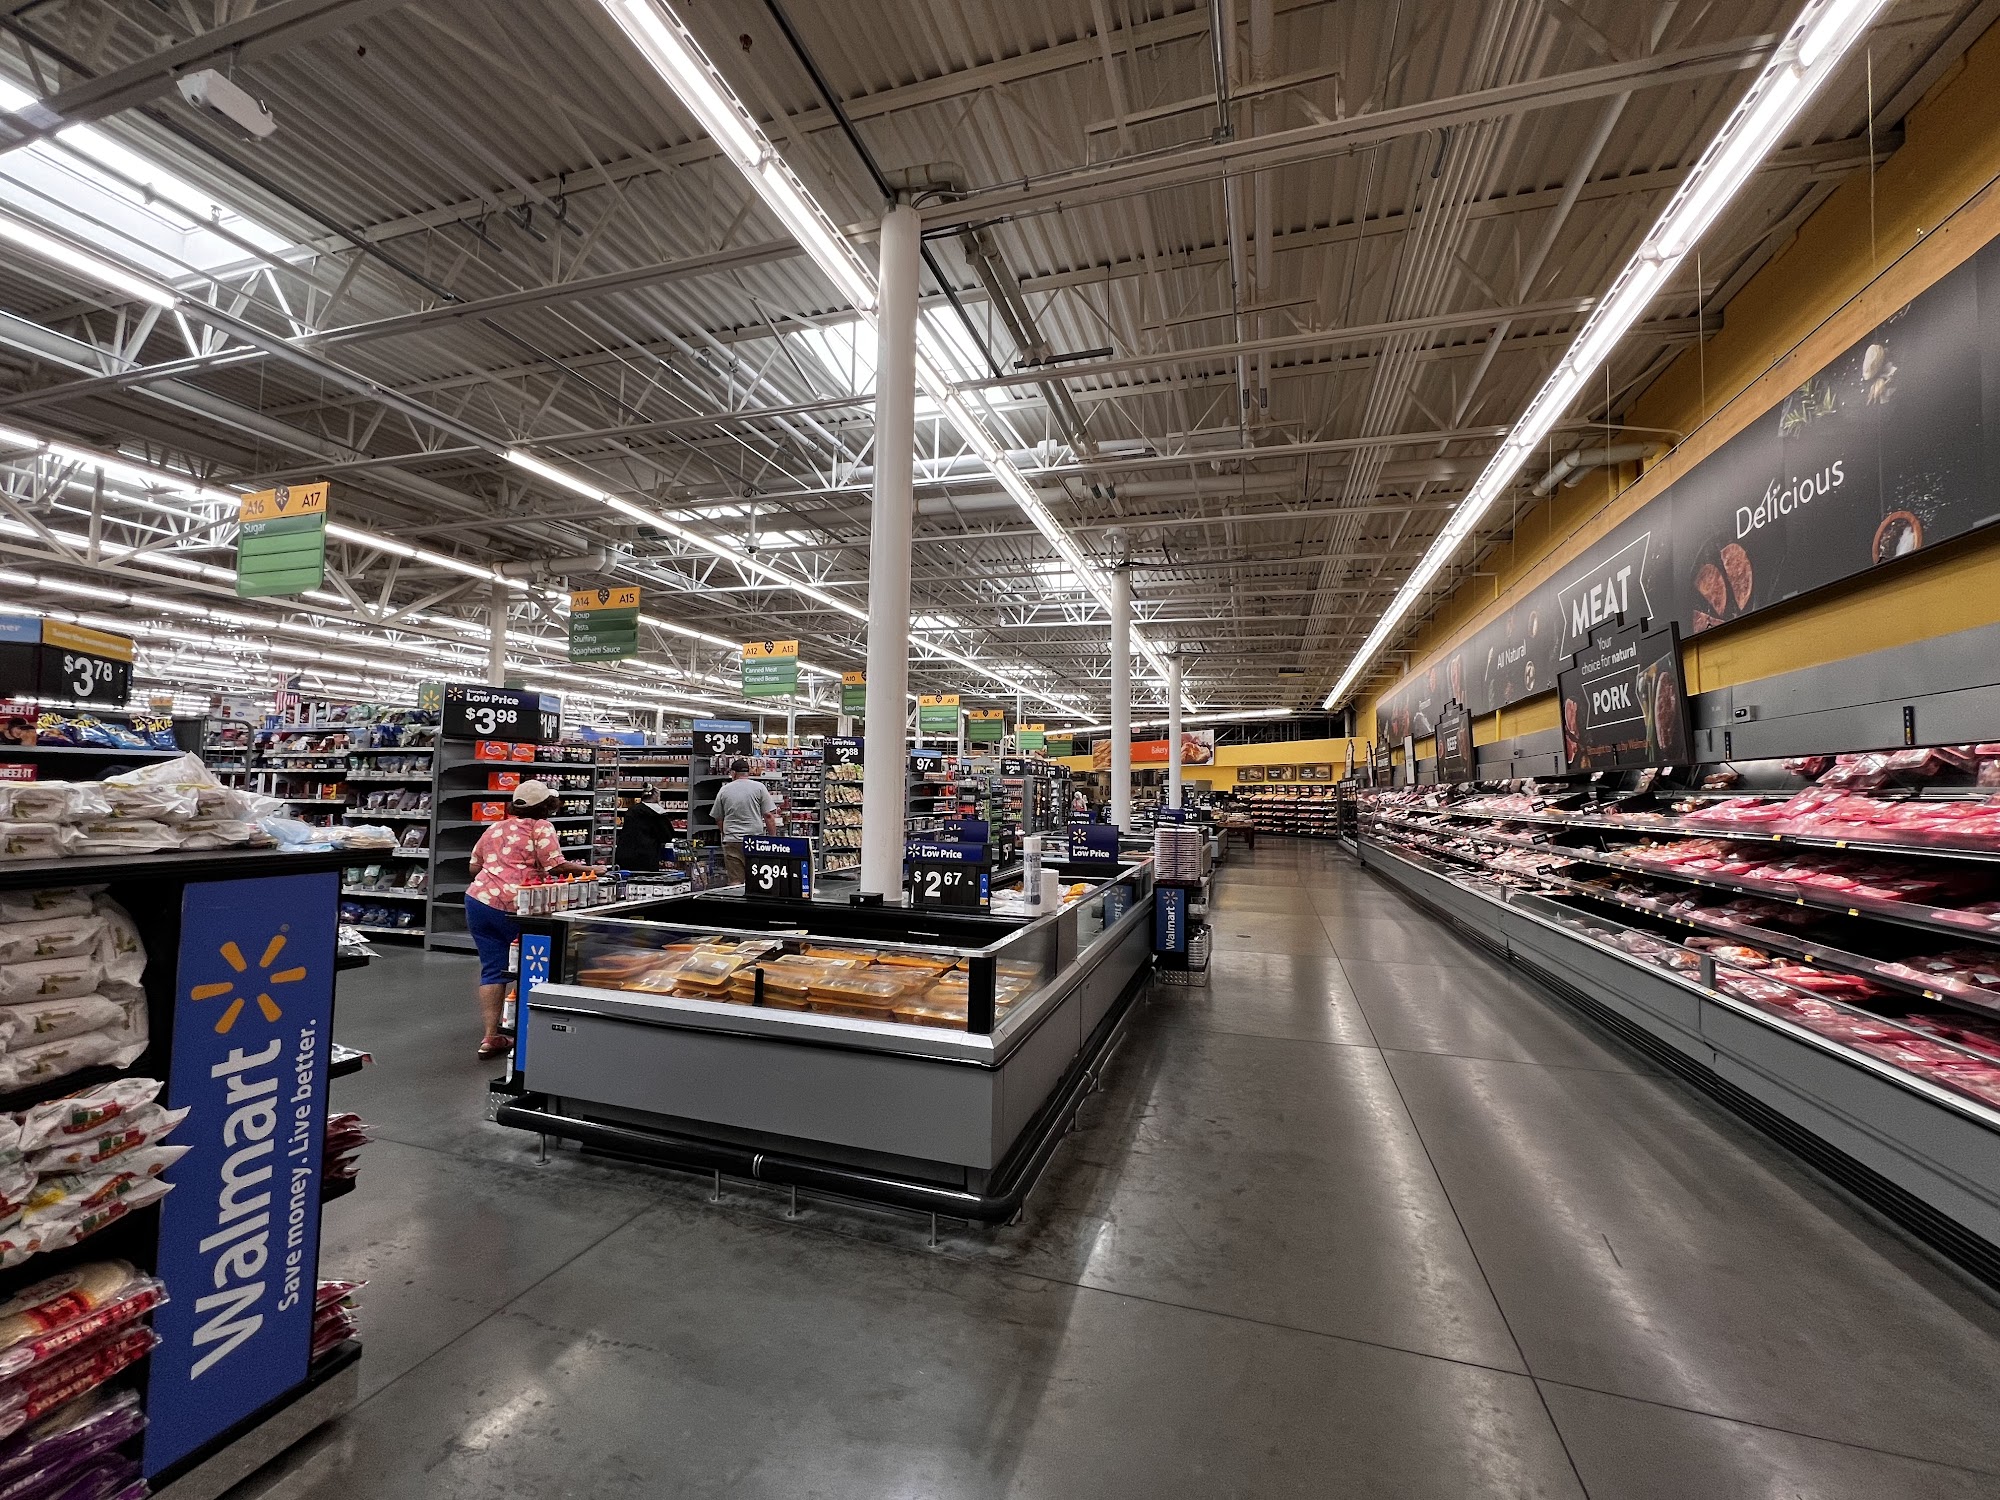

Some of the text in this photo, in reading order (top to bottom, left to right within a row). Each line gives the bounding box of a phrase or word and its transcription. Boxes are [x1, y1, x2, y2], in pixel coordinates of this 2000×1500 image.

[245, 491, 321, 515] A16 A17
[1736, 460, 1845, 538] Delicious
[243, 523, 266, 535] Sugar
[573, 593, 635, 607] A14 A15
[1572, 565, 1632, 638] MEAT
[574, 611, 590, 620] Soup
[573, 623, 590, 631] Pasta
[573, 634, 597, 644] Stuffing
[1597, 636, 1612, 650] Your
[572, 645, 621, 656] Spaghetti Sauce
[745, 645, 794, 656] A12 A13
[1497, 639, 1527, 669] All Natural
[1581, 642, 1637, 676] choice for natural
[745, 666, 765, 674] Canned
[744, 675, 765, 683] Canned
[466, 692, 520, 706] Low Price
[1592, 682, 1632, 715] PORK
[1151, 746, 1168, 756] Bakery
[1446, 736, 1458, 752] BEEF
[756, 843, 791, 853] Low Price
[921, 848, 963, 859] Low Price
[1072, 849, 1110, 858] Low Price
[1165, 906, 1176, 950] Walmart
[277, 1019, 317, 1312] Save money. Live better.
[190, 1038, 283, 1381] Walmart
